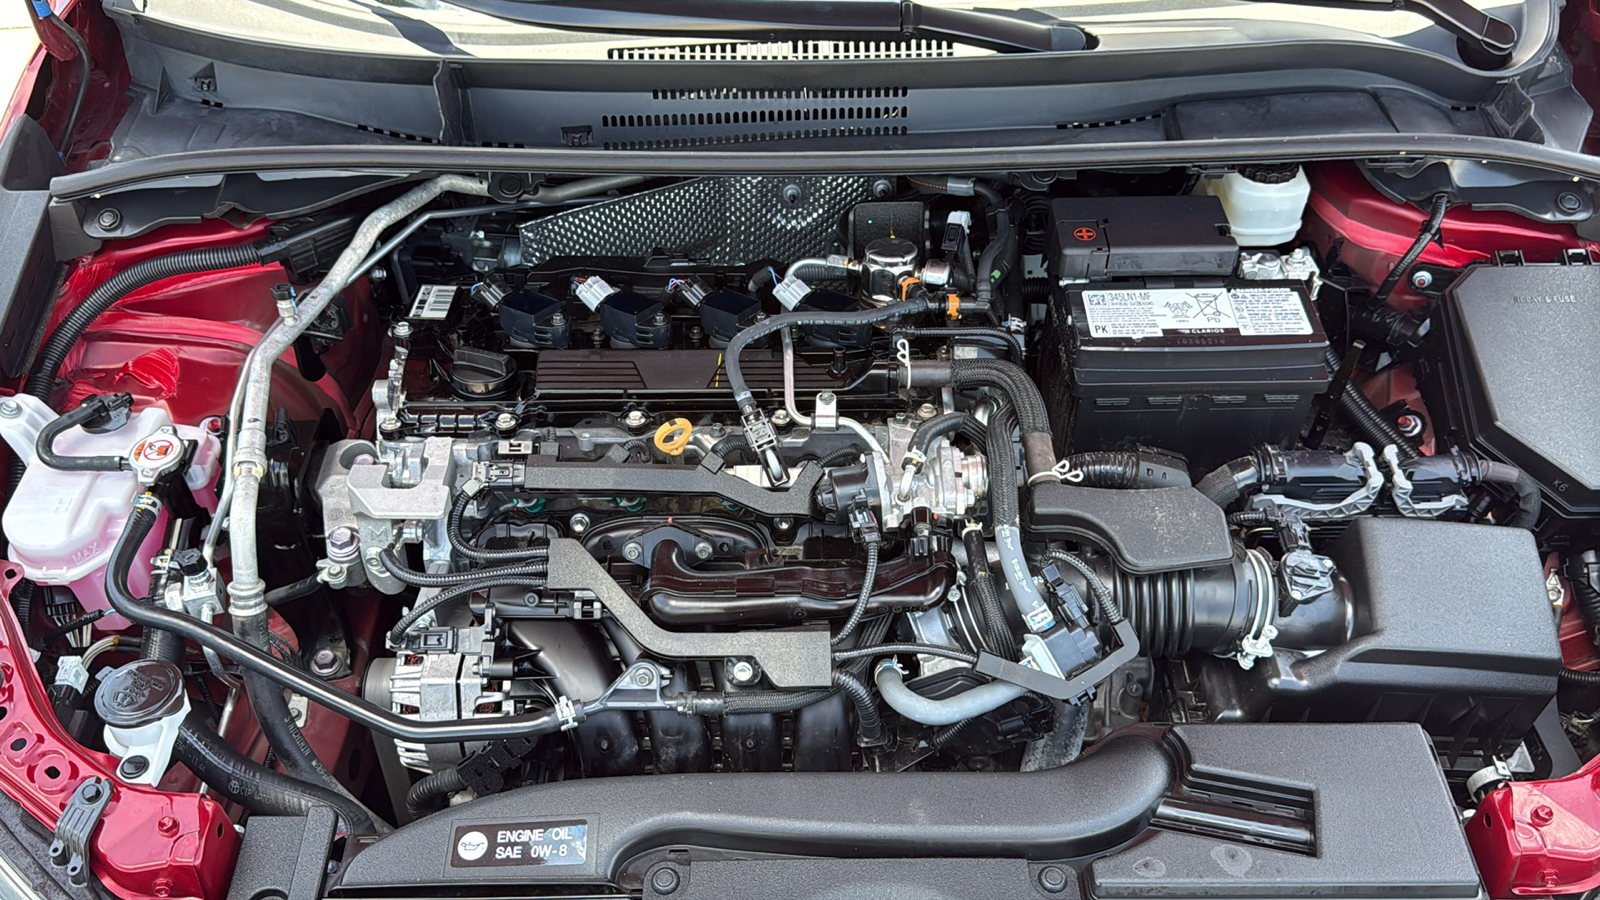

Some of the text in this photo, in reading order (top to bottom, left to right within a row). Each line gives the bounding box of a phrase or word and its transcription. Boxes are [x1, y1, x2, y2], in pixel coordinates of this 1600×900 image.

[1108, 292, 1151, 301] 345LN1-MF
[1553, 295, 1576, 303] FUSE
[1095, 325, 1108, 334] PK
[72, 542, 101, 565] MAX
[497, 827, 573, 843] ENGINE OIL
[495, 844, 567, 859] SAE 0W-8
